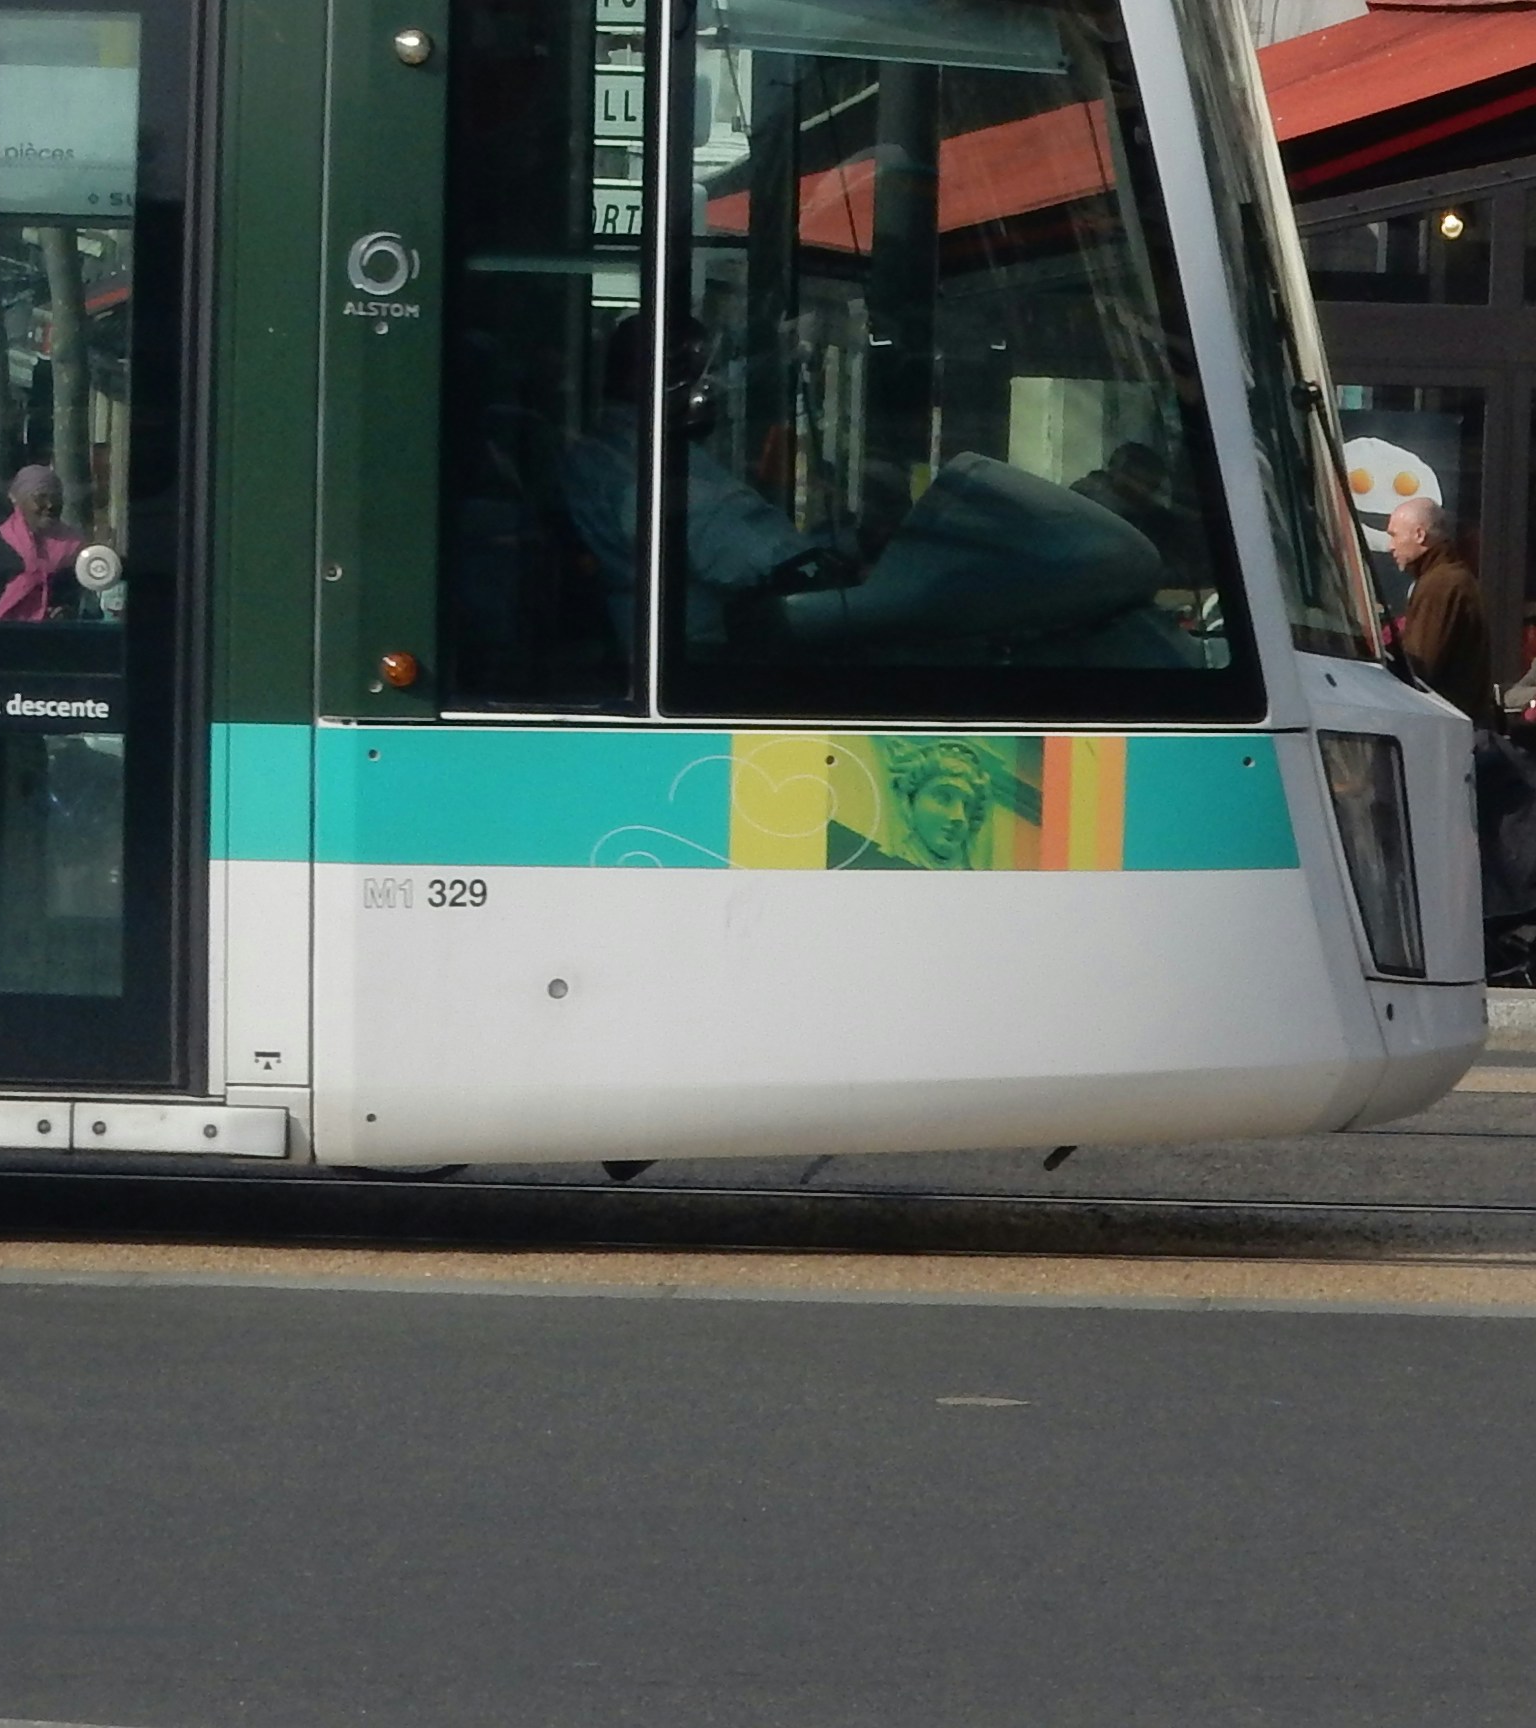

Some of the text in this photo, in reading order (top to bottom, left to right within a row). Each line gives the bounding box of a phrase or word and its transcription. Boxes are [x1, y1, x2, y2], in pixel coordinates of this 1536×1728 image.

[343, 301, 421, 318] ALSTOM
[6, 693, 109, 719] descente
[364, 878, 488, 909] M1 329
